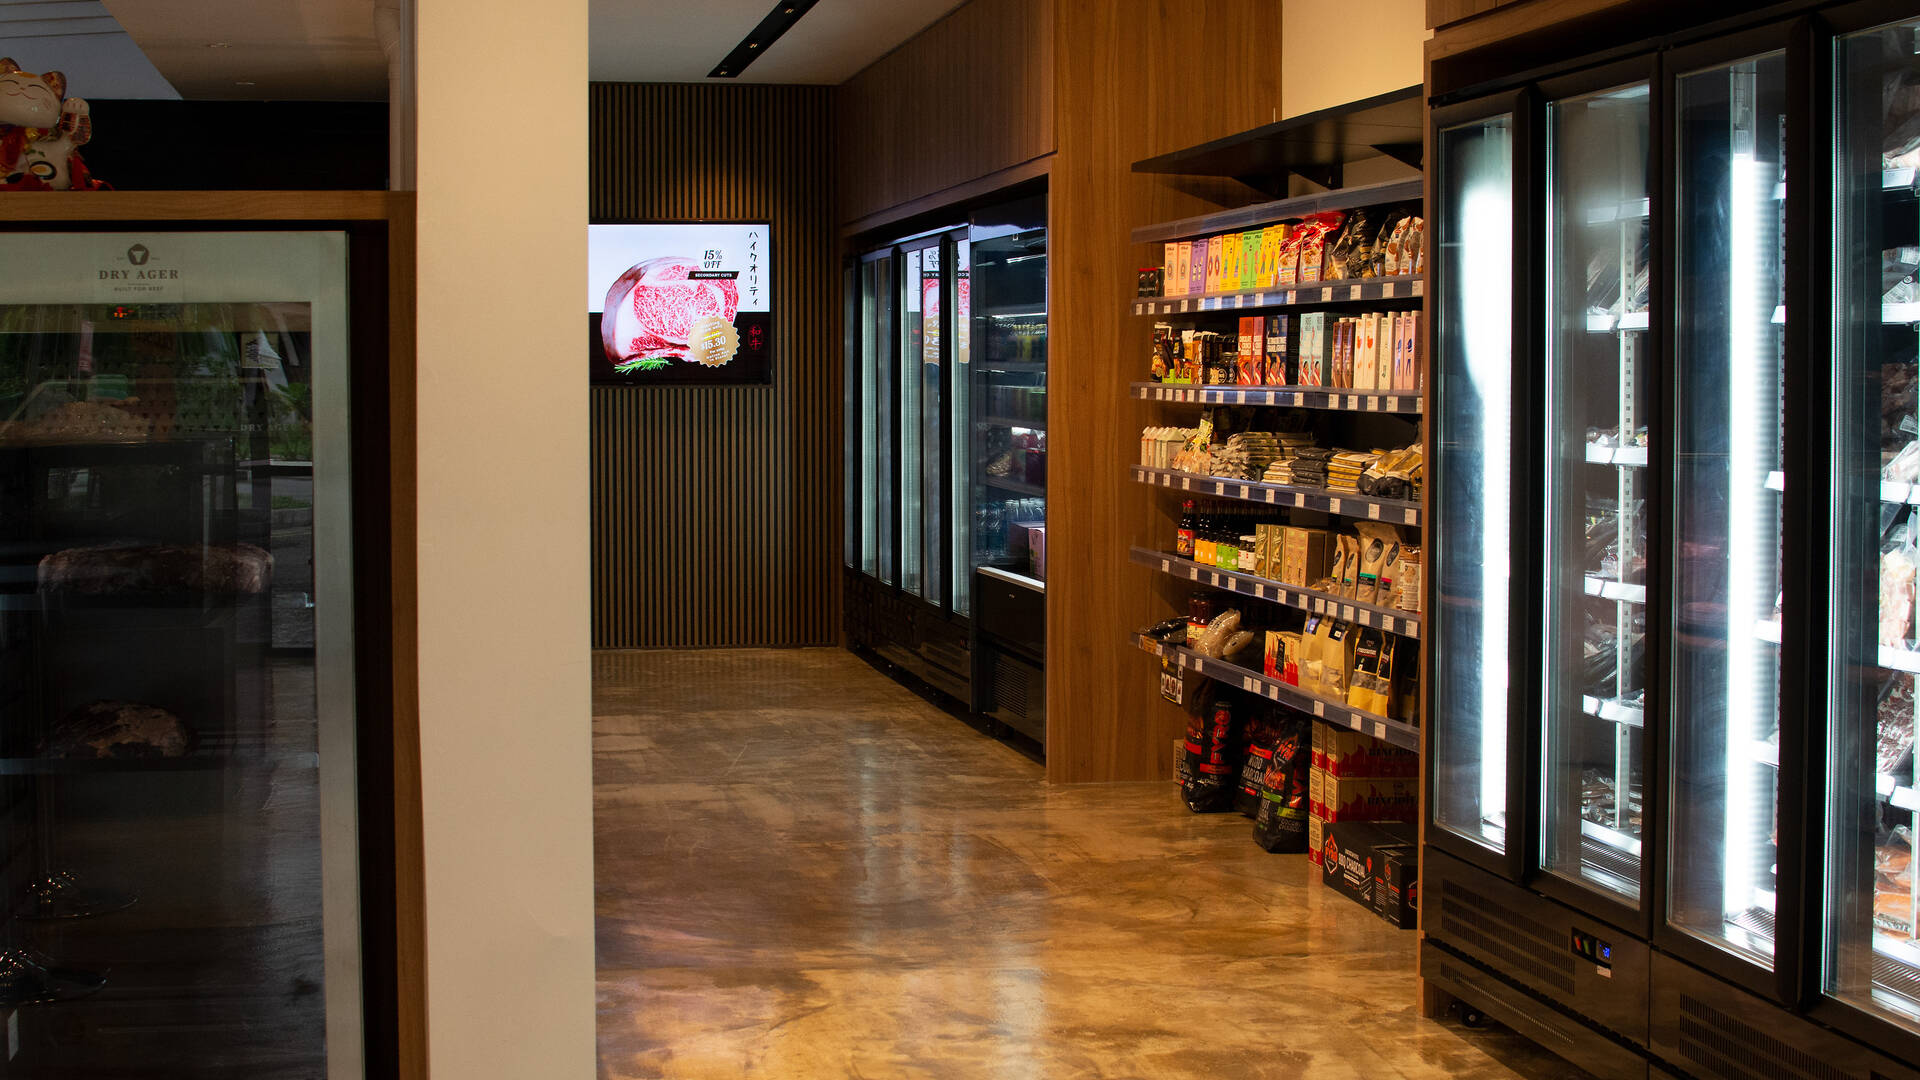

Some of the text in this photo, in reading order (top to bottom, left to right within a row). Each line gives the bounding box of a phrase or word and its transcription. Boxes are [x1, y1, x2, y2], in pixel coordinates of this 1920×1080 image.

[704, 249, 723, 260] 15%
[704, 260, 721, 269] OFF
[749, 231, 759, 306] ハイクオリティ
[99, 270, 179, 280] DRY AGER
[750, 326, 762, 352] 和牛
